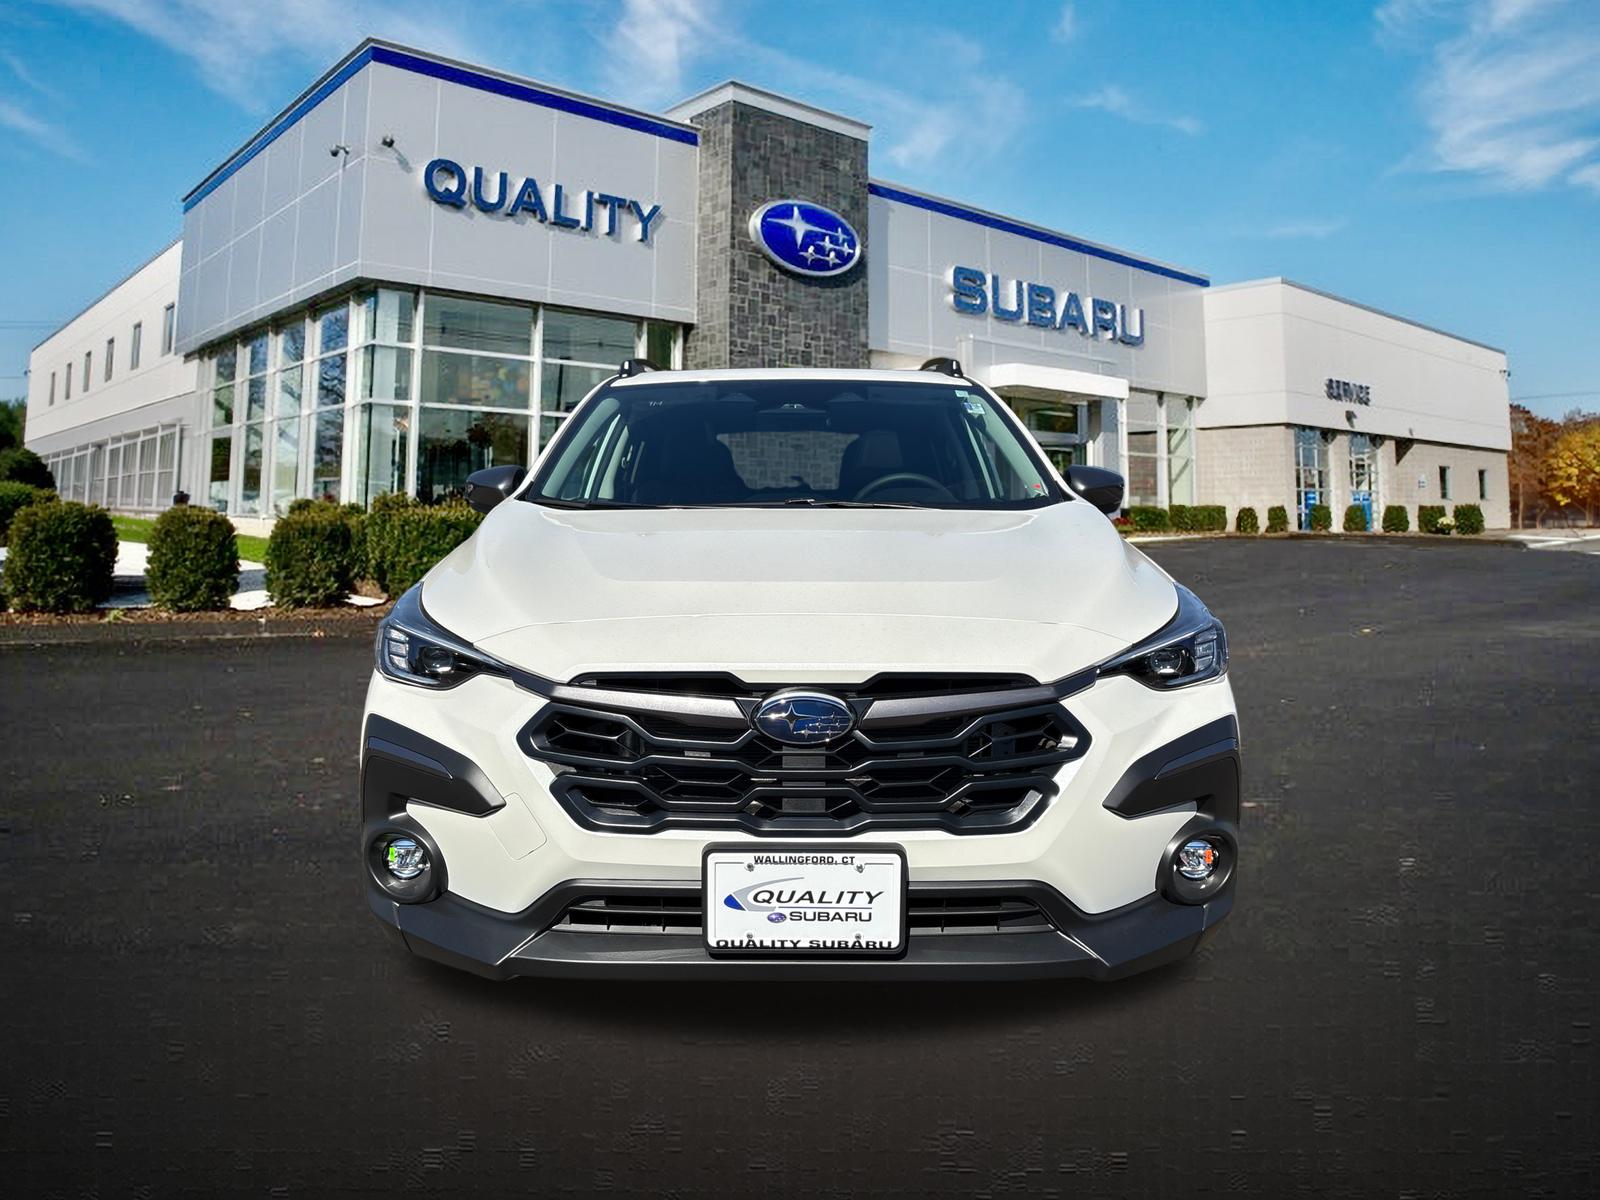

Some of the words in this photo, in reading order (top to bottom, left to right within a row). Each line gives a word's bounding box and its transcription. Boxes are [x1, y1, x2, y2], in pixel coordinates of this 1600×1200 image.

[424, 158, 661, 242] QUALITY
[947, 265, 1145, 346] SUBARU
[1325, 378, 1371, 406] SERVICE
[753, 855, 838, 865] WALLINGFORD,
[841, 855, 855, 865] CT
[752, 889, 884, 905] QUALITY
[789, 911, 873, 922] SUBARU
[715, 939, 801, 949] QUALITY
[808, 939, 892, 949] SUBARU
